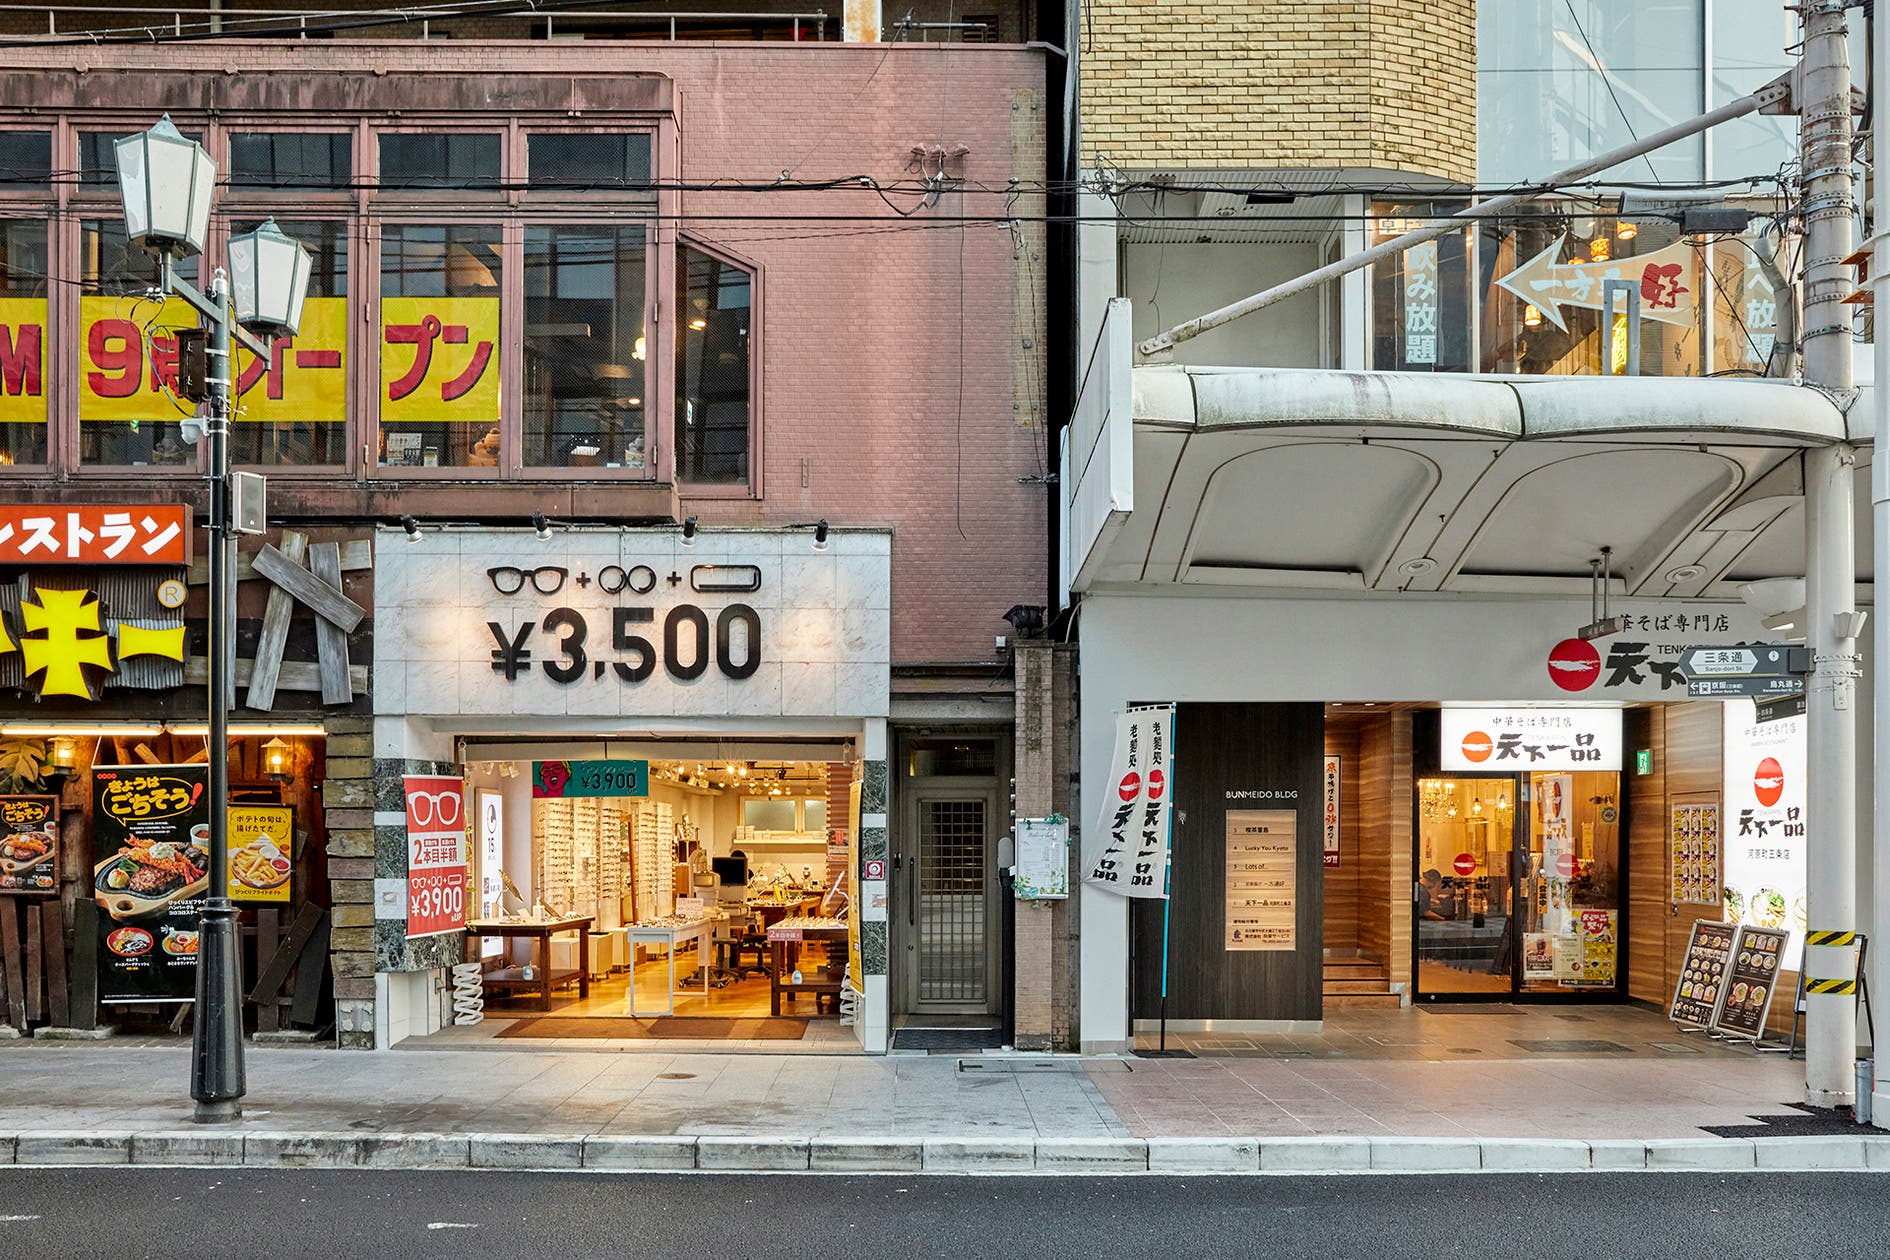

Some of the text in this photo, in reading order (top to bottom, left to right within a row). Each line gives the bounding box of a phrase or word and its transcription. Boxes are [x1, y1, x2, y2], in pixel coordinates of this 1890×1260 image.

[0, 588, 186, 700] キー
[487, 604, 761, 683] ¥3,500
[1705, 651, 1743, 663] 三条通
[1493, 716, 1572, 728] 中華そば専門店
[1496, 733, 1601, 762] 天下一品
[108, 776, 160, 793] きょうは
[581, 772, 636, 791] ¥3,900
[1225, 790, 1298, 799] BUNMEIDO BLDG
[111, 782, 203, 815] ごちそう!
[1739, 806, 1805, 838] 天下一品
[414, 840, 458, 865] 2本目半額
[1131, 802, 1161, 886] 天下一品
[411, 886, 462, 919] ¥3,900
